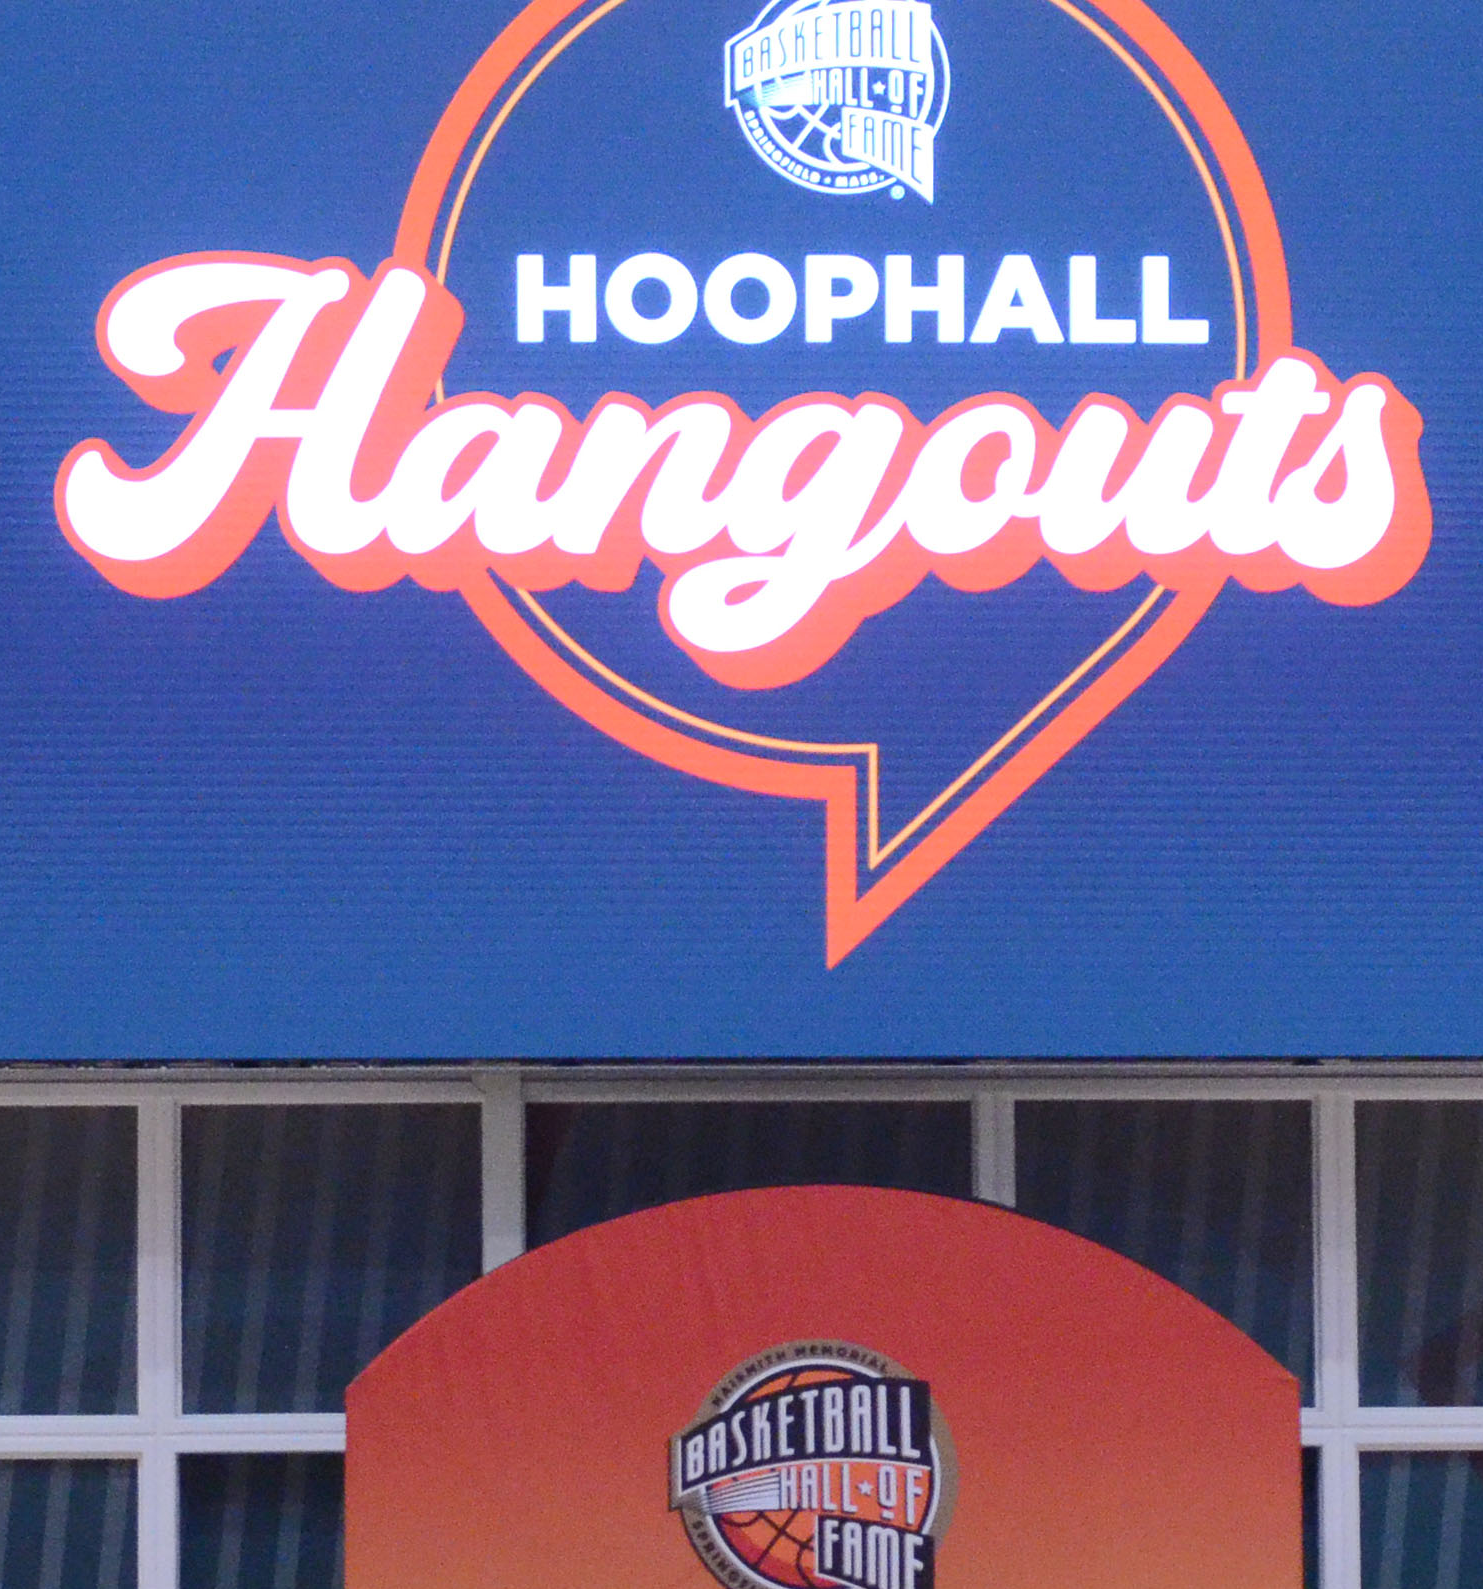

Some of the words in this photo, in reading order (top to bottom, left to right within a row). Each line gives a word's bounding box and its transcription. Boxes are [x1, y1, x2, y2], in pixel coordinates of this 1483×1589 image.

[742, 8, 921, 79] BASKETBALL
[812, 66, 874, 109] HALL
[887, 68, 927, 119] OF
[848, 113, 923, 185] FAME
[517, 253, 1210, 345] HOOPHALL
[60, 262, 1402, 656] Hangouts
[794, 1345, 888, 1373] MEMORIAL
[685, 1384, 922, 1483] BASKETBALL
[780, 1463, 859, 1513] HALL
[878, 1465, 923, 1526] OF
